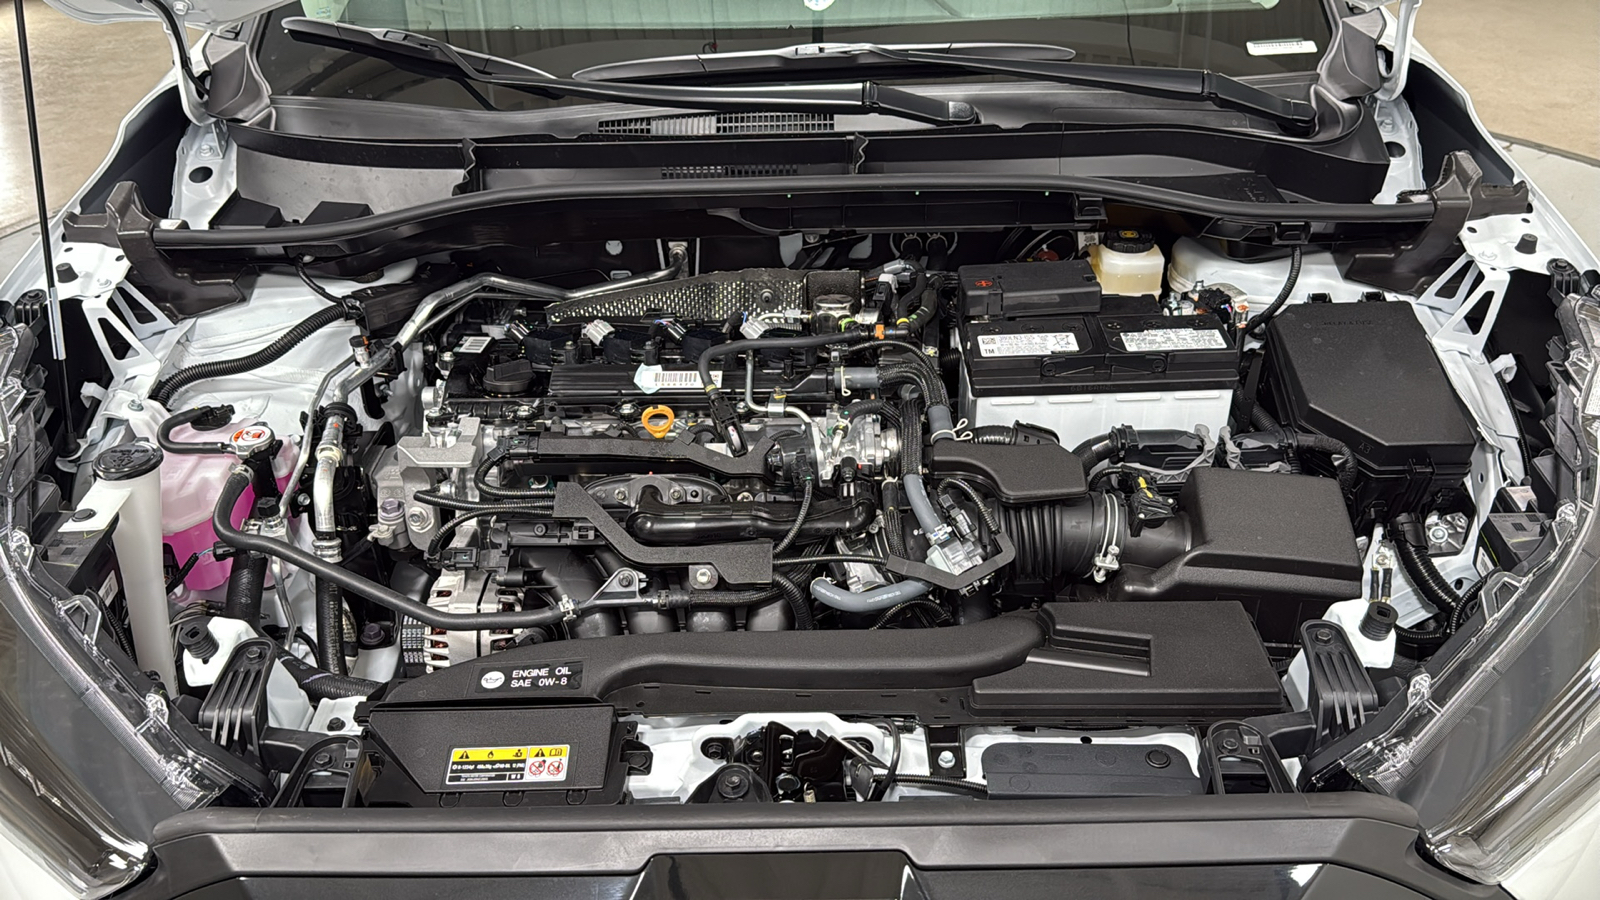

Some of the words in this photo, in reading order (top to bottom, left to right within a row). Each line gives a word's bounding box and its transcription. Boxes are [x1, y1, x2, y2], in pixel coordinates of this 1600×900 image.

[1358, 442, 1372, 454] A3
[512, 668, 550, 678] ENGINE
[555, 667, 572, 676] OIL
[510, 679, 532, 688] SAE
[538, 677, 568, 687] 0W-8
